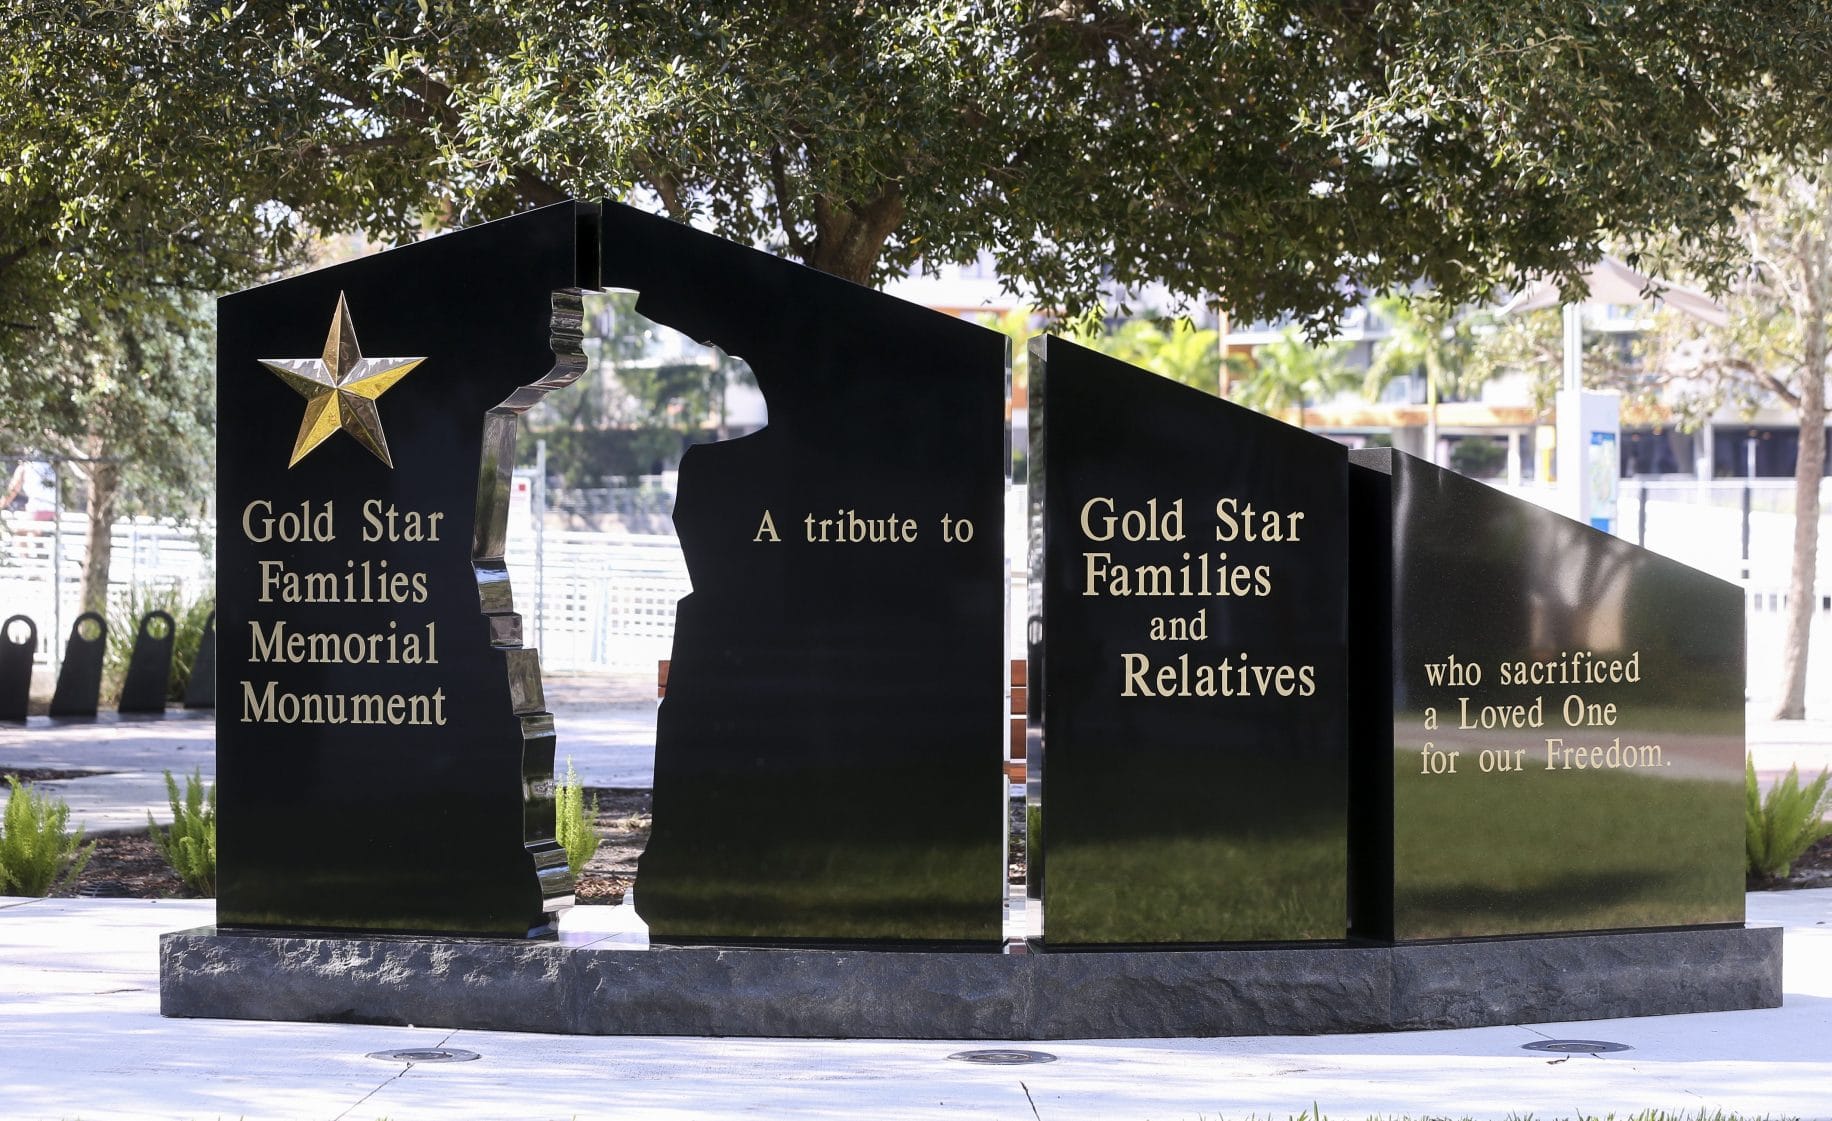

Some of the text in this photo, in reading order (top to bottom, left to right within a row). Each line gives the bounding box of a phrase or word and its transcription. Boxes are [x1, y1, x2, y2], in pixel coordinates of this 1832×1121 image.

[242, 499, 444, 543] Gold Star
[753, 510, 974, 543] A tribute to
[1080, 497, 1305, 542] Gold Star
[258, 559, 428, 603] Families
[1083, 552, 1272, 597] Families
[248, 620, 438, 664] Memorial
[1149, 607, 1208, 641] and
[1120, 652, 1316, 697] Relatives
[1424, 650, 1641, 686] who sacrificed
[240, 681, 447, 726] Monument
[1424, 694, 1617, 730] a Loved One
[1421, 737, 1671, 774] for our Freedom.
